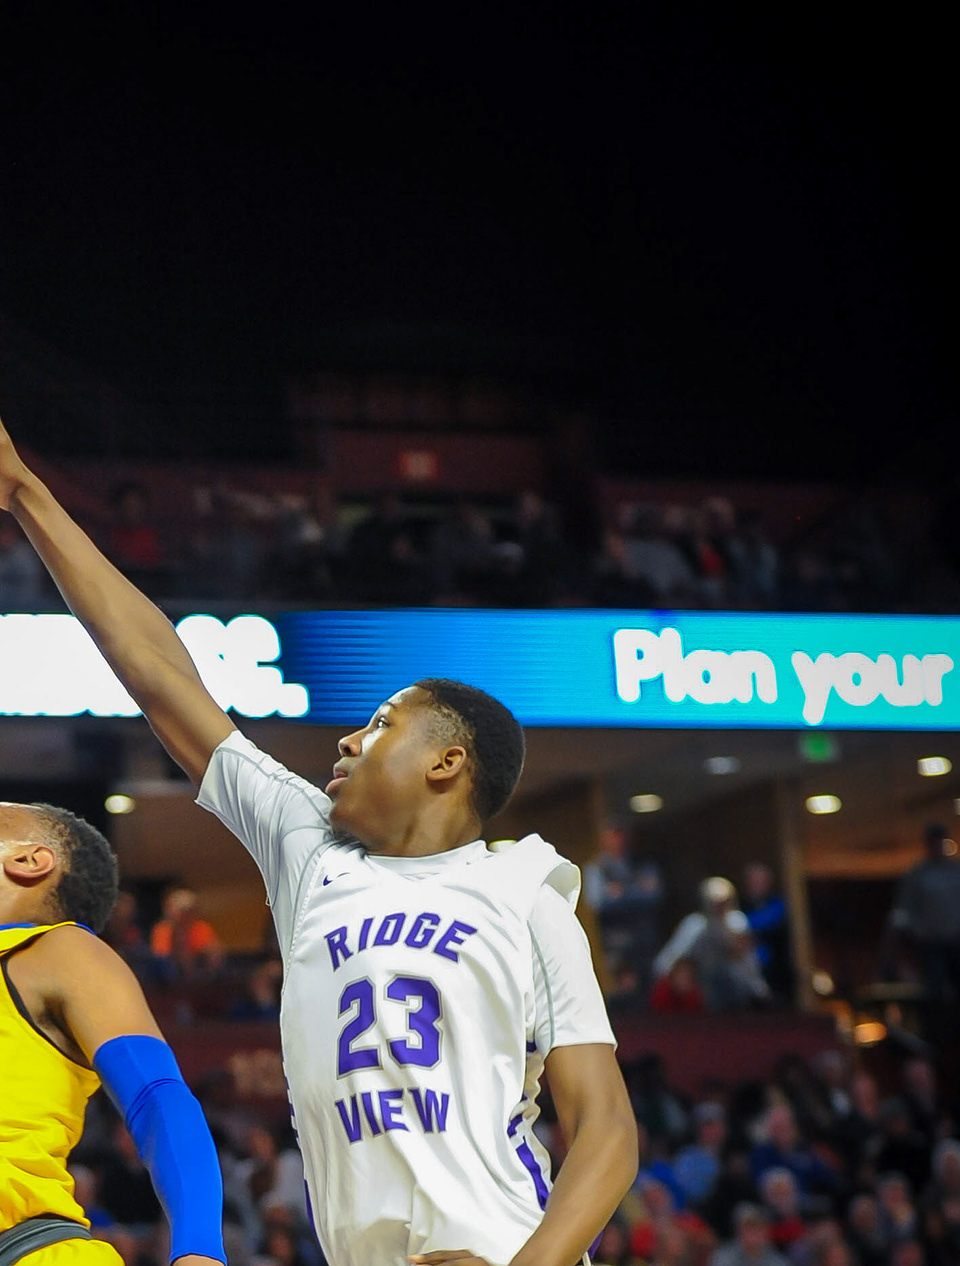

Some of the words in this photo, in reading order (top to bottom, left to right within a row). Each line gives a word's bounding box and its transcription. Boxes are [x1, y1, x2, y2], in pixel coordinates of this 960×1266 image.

[612, 626, 778, 704] Plan
[791, 651, 955, 725] your
[324, 911, 478, 972] RIDGE
[336, 972, 444, 1080] 23
[335, 1087, 450, 1144] VIEW
